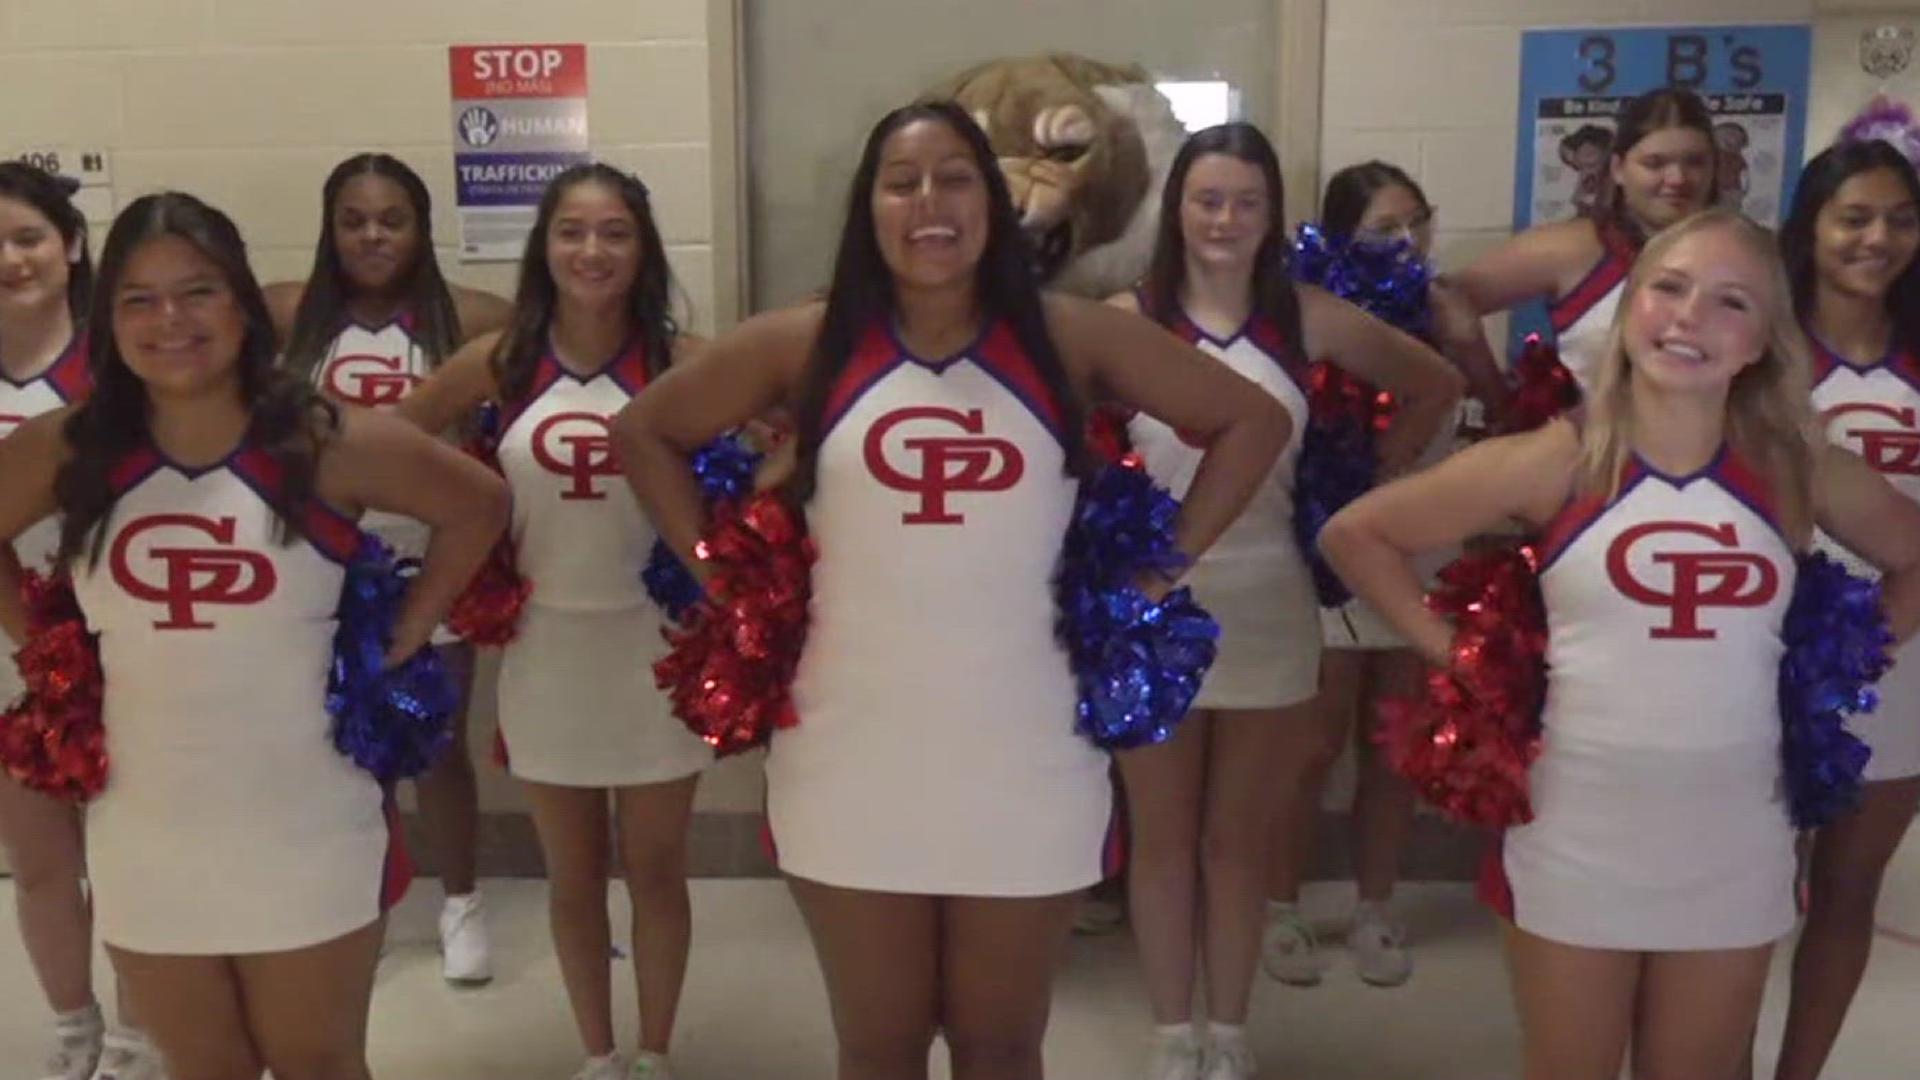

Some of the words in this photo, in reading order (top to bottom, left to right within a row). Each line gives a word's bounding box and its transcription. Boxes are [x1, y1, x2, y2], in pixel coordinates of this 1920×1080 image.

[473, 51, 562, 79] STOP
[1578, 35, 1616, 92] 3
[501, 117, 584, 136] HUMAN
[863, 406, 1025, 526] GP
[109, 514, 277, 630] GP
[1606, 520, 1779, 640] GP
